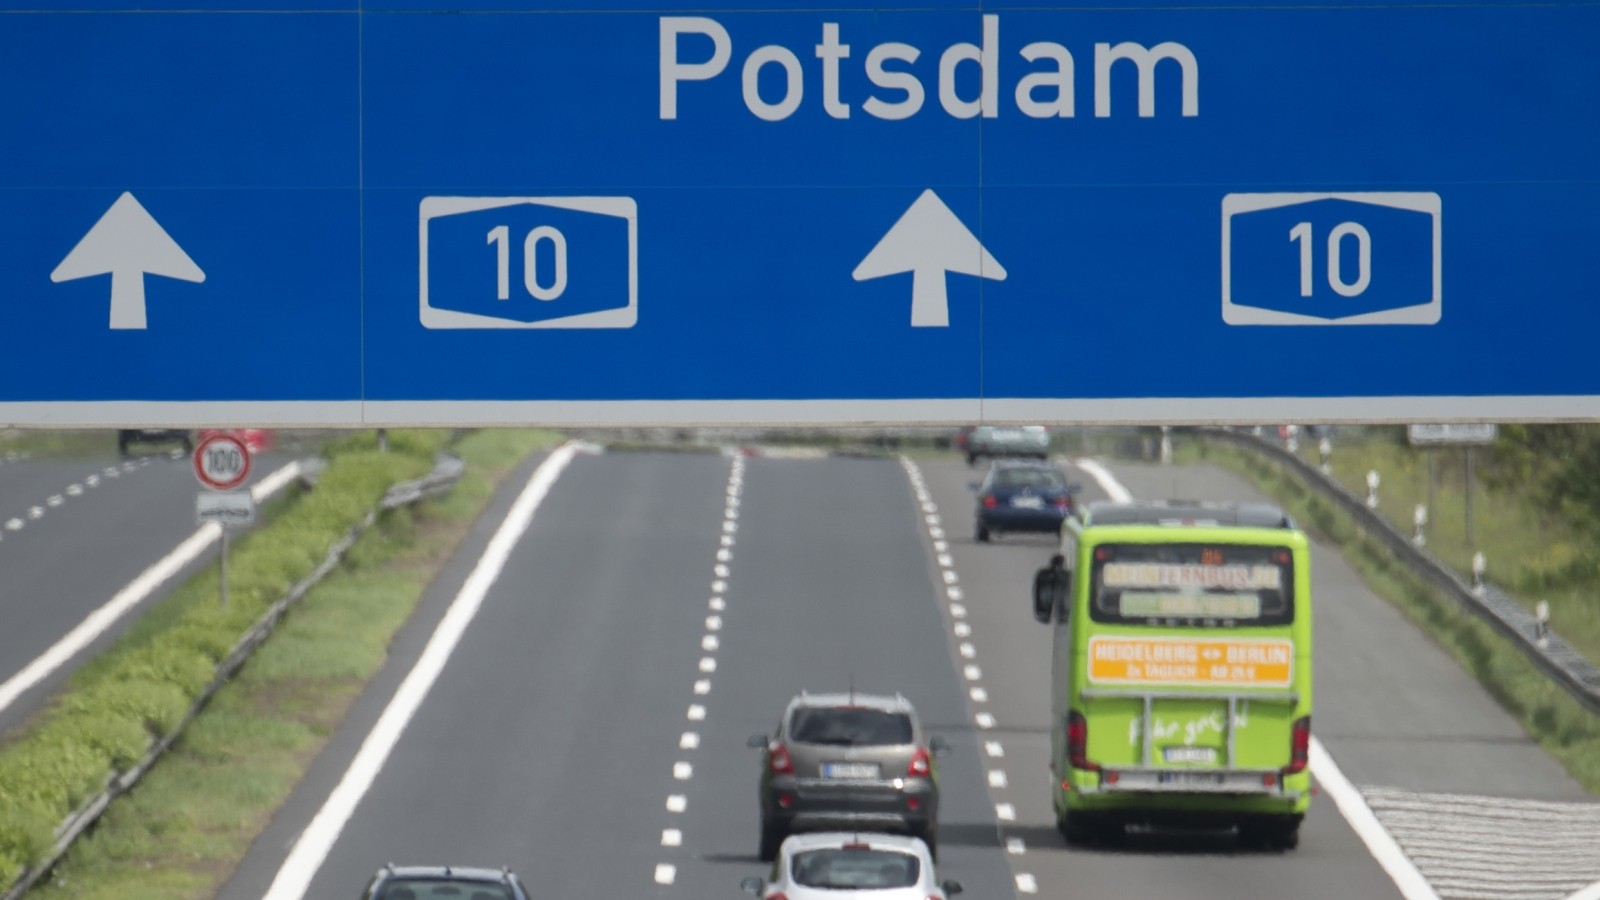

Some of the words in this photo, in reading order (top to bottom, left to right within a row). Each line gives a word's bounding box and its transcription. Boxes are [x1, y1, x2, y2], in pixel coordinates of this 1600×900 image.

[660, 14, 1198, 121] Potsdam
[487, 225, 568, 301] 10
[1289, 221, 1371, 297] 10
[1096, 643, 1197, 662] HEIDELBERG
[1227, 646, 1288, 664] BERLIN
